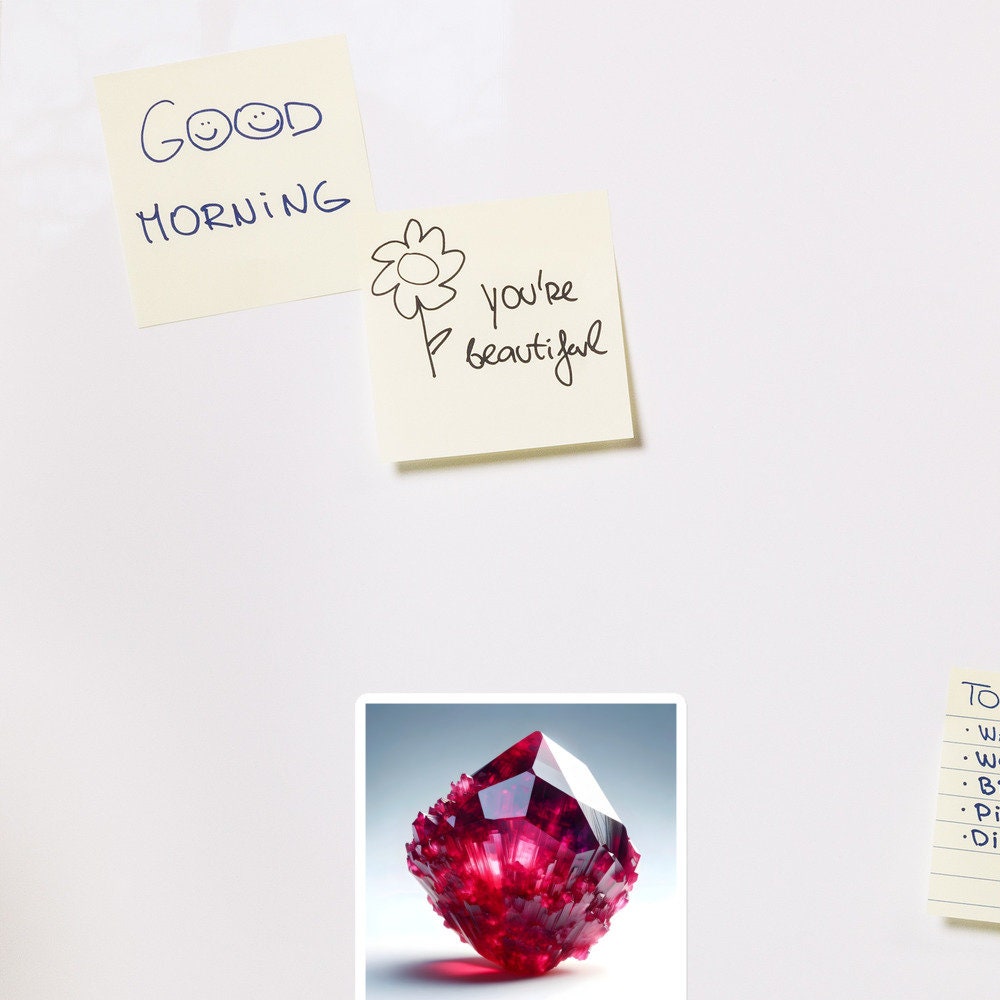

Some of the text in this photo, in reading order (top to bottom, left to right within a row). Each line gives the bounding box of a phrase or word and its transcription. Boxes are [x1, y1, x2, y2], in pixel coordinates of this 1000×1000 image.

[140, 99, 323, 163] GOOD
[465, 319, 608, 386] beautiful
[961, 681, 1000, 709] TO
